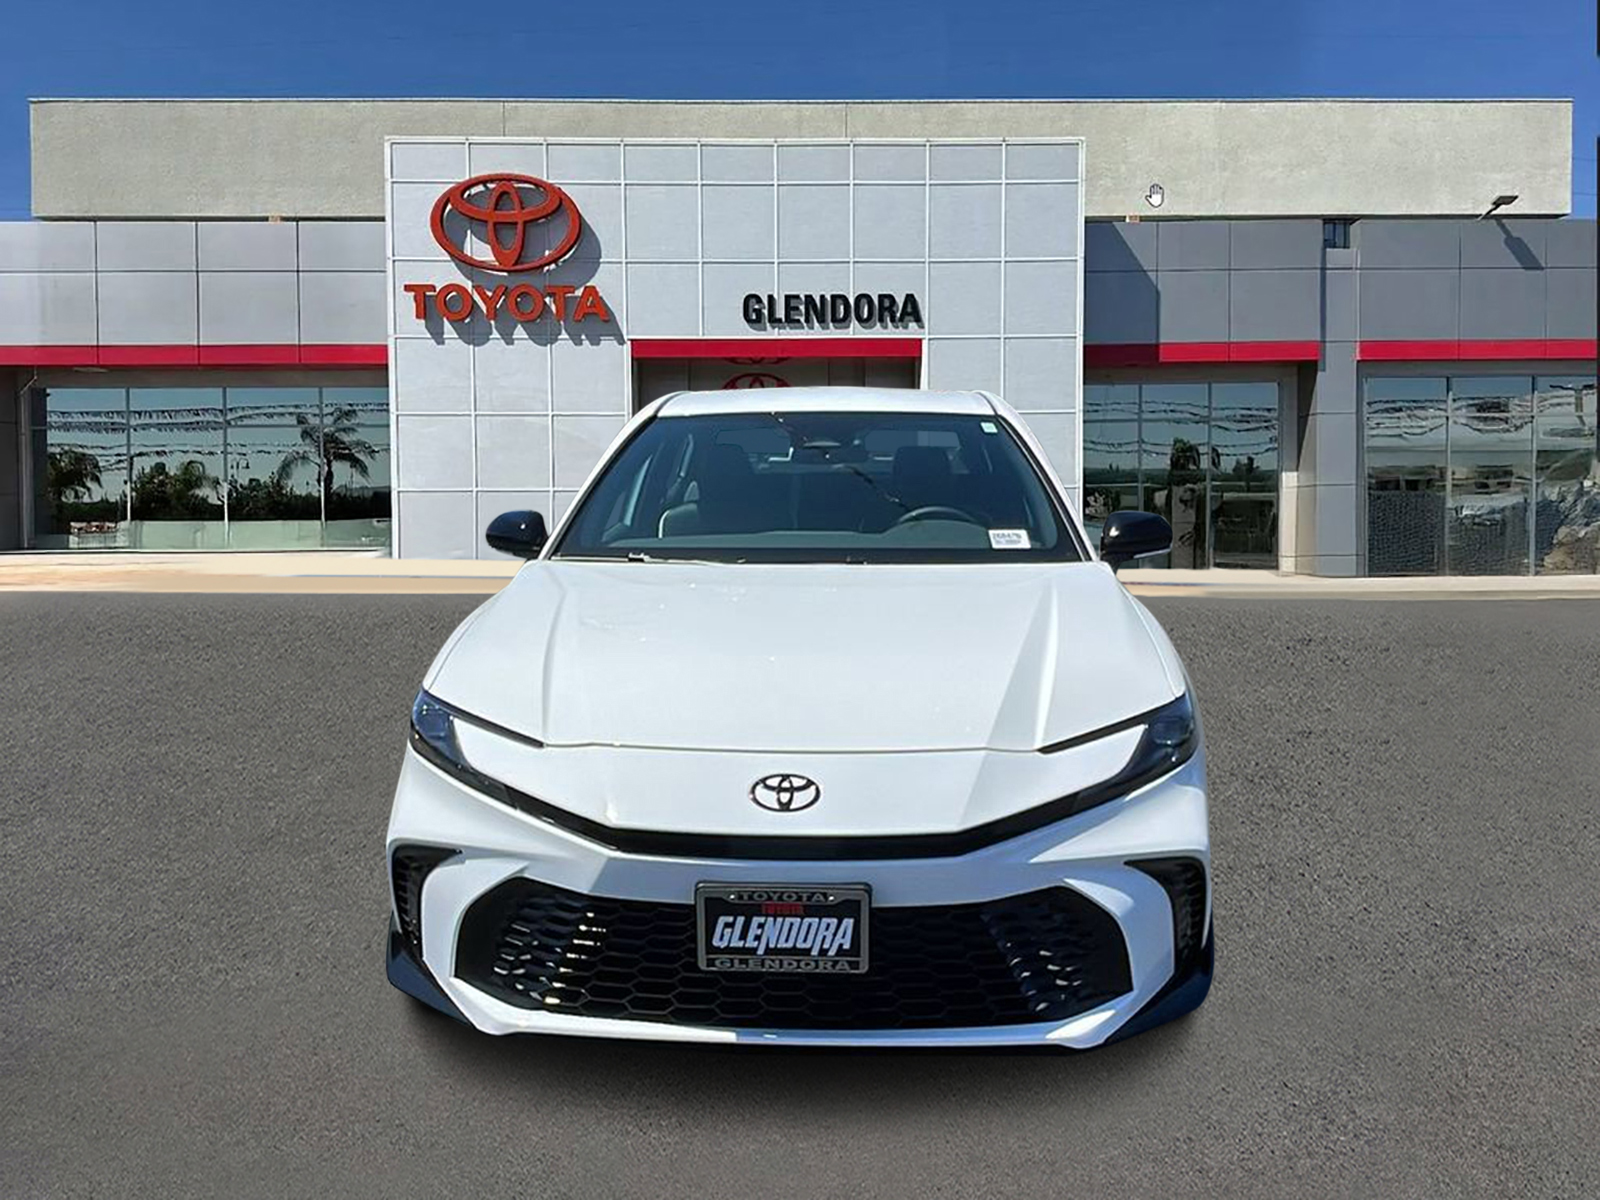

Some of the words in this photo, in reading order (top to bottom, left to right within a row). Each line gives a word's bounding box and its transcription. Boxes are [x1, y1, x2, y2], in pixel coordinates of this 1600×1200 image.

[404, 283, 610, 322] TOYOTA
[743, 293, 922, 324] GLENDORA
[738, 891, 827, 902] TOYOTA
[712, 915, 854, 956] GLENDORA
[714, 957, 850, 971] GLENDORA
